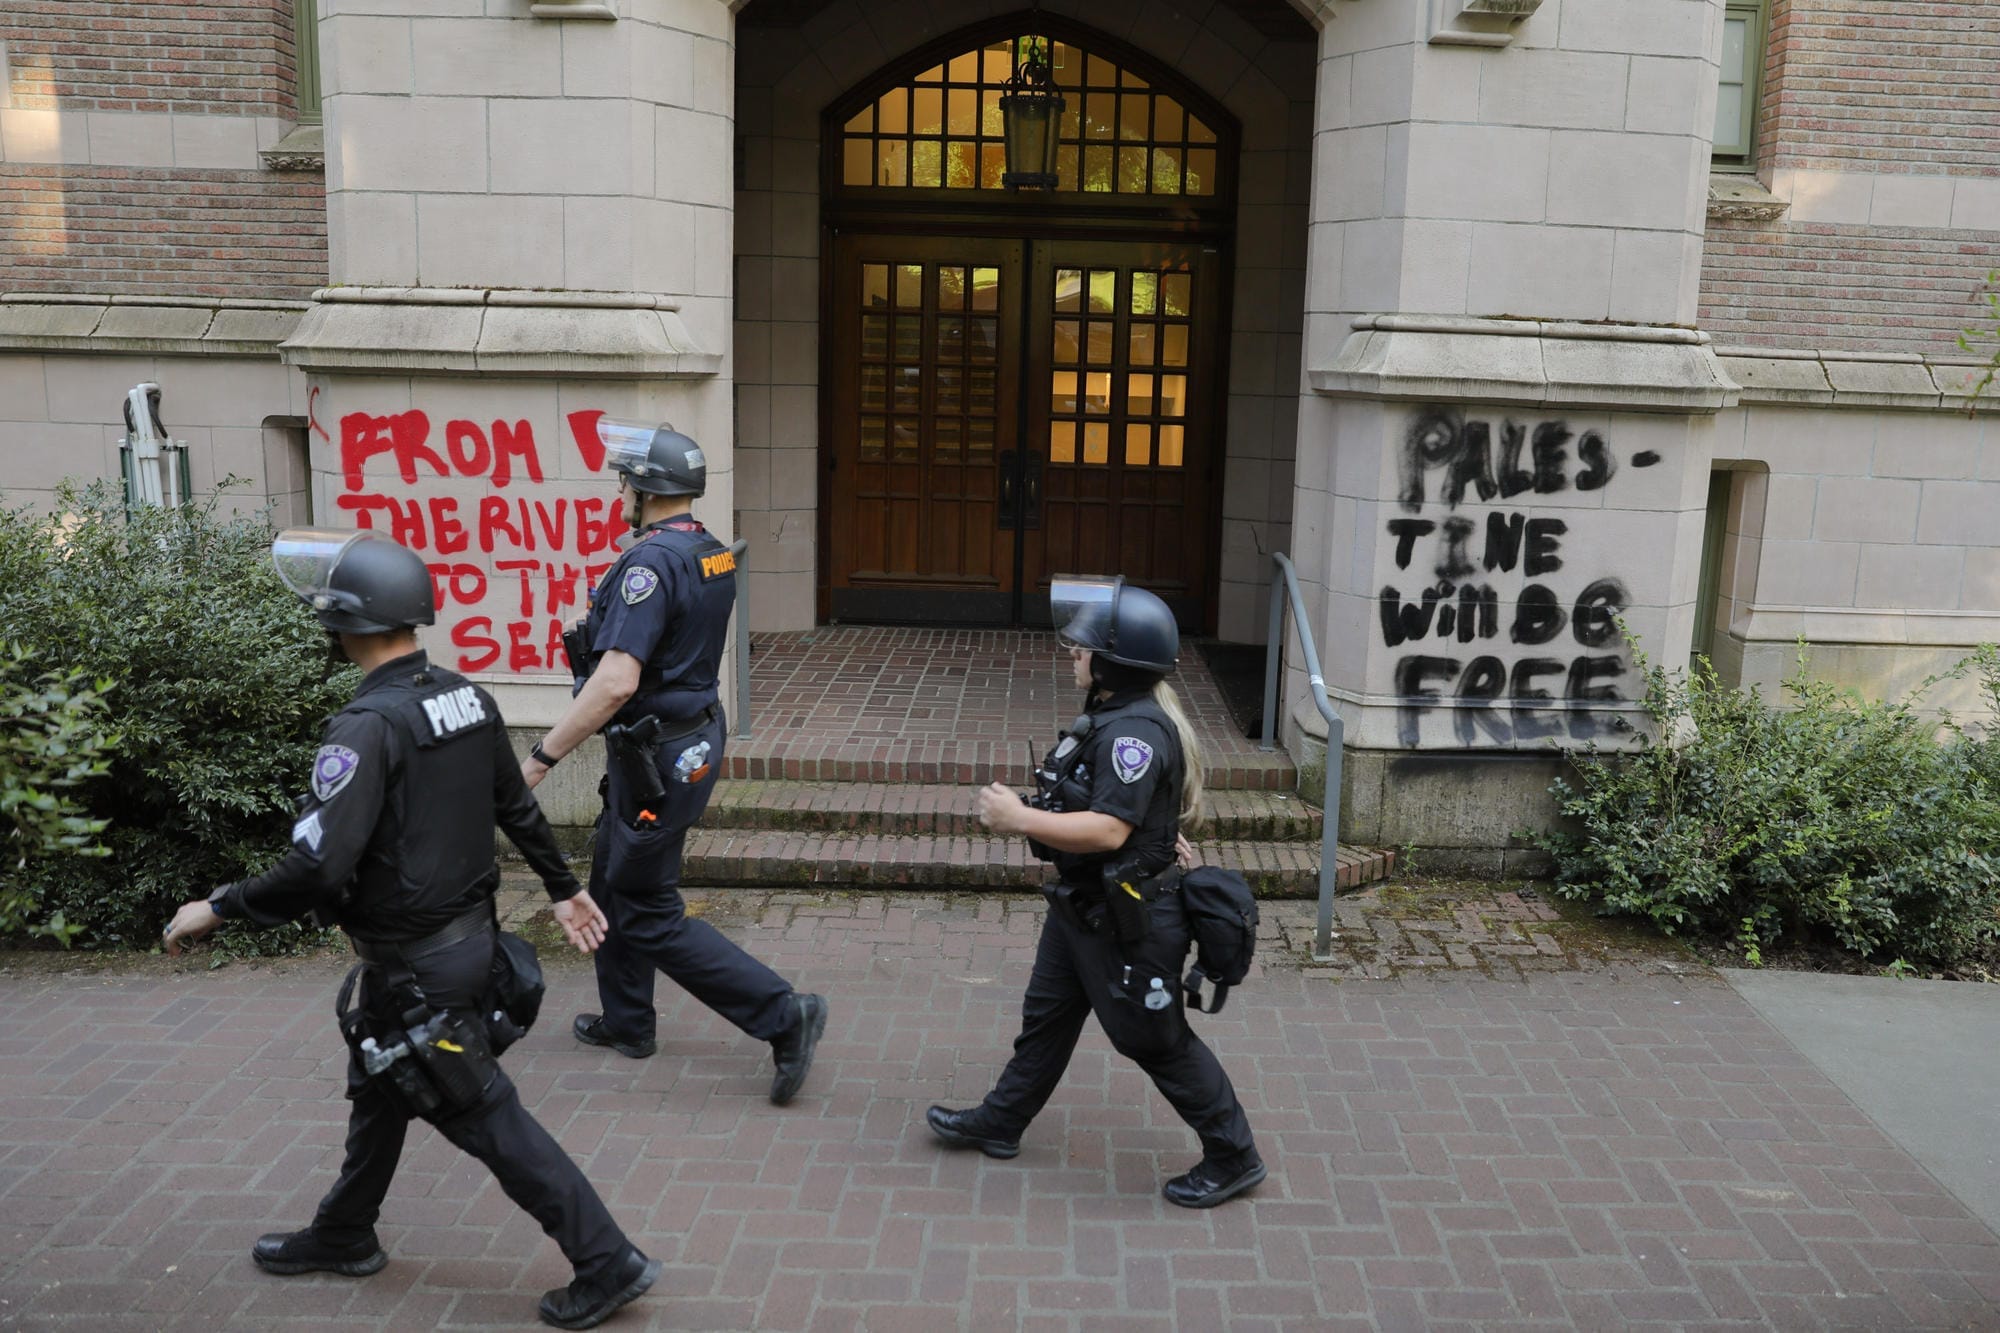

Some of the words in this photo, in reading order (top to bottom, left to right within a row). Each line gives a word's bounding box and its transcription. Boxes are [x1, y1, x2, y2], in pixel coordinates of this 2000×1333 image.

[340, 409, 544, 491] FROM
[337, 493, 469, 555] THE
[1386, 511, 1569, 579] TINE
[422, 686, 486, 737] POLICE
[1394, 654, 1634, 749] FREE
